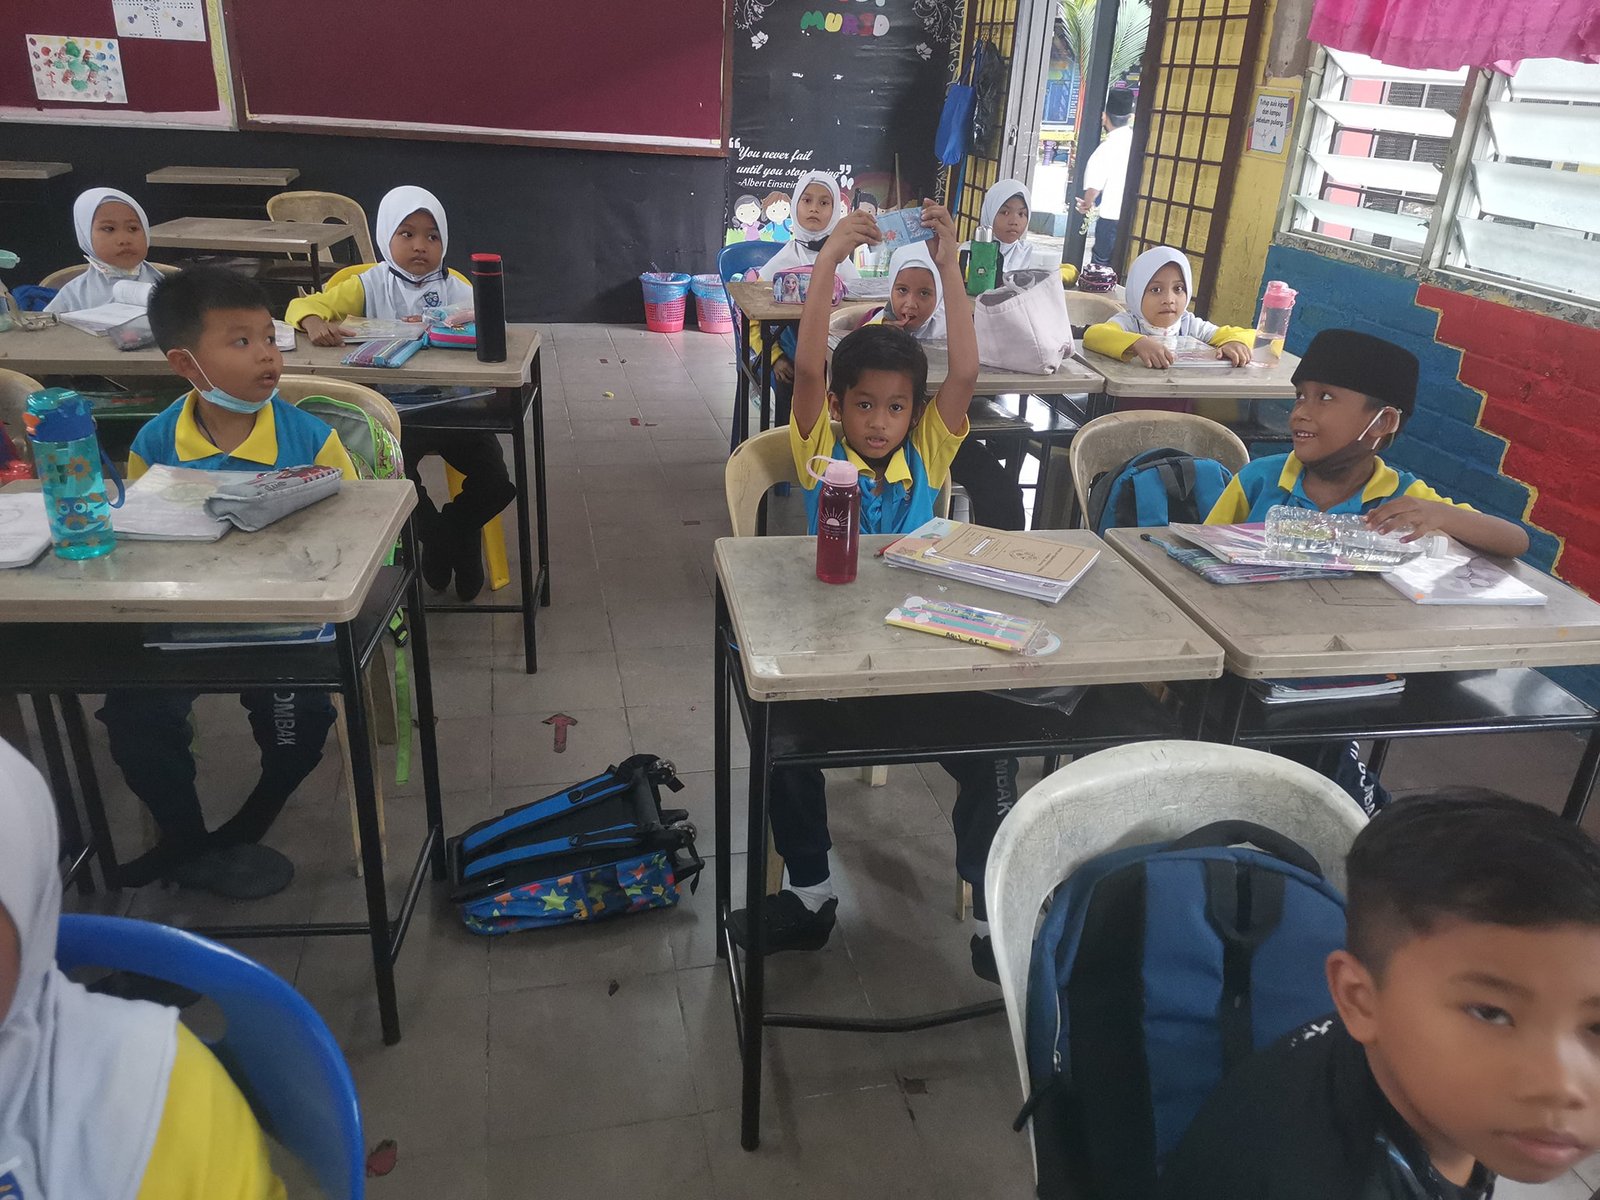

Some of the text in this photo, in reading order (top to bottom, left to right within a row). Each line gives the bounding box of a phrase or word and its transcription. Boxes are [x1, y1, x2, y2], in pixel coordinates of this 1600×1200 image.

[762, 151, 789, 160] never
[790, 149, 813, 163] fail
[736, 164, 763, 174] until
[763, 167, 783, 178] you
[785, 167, 807, 179] stop
